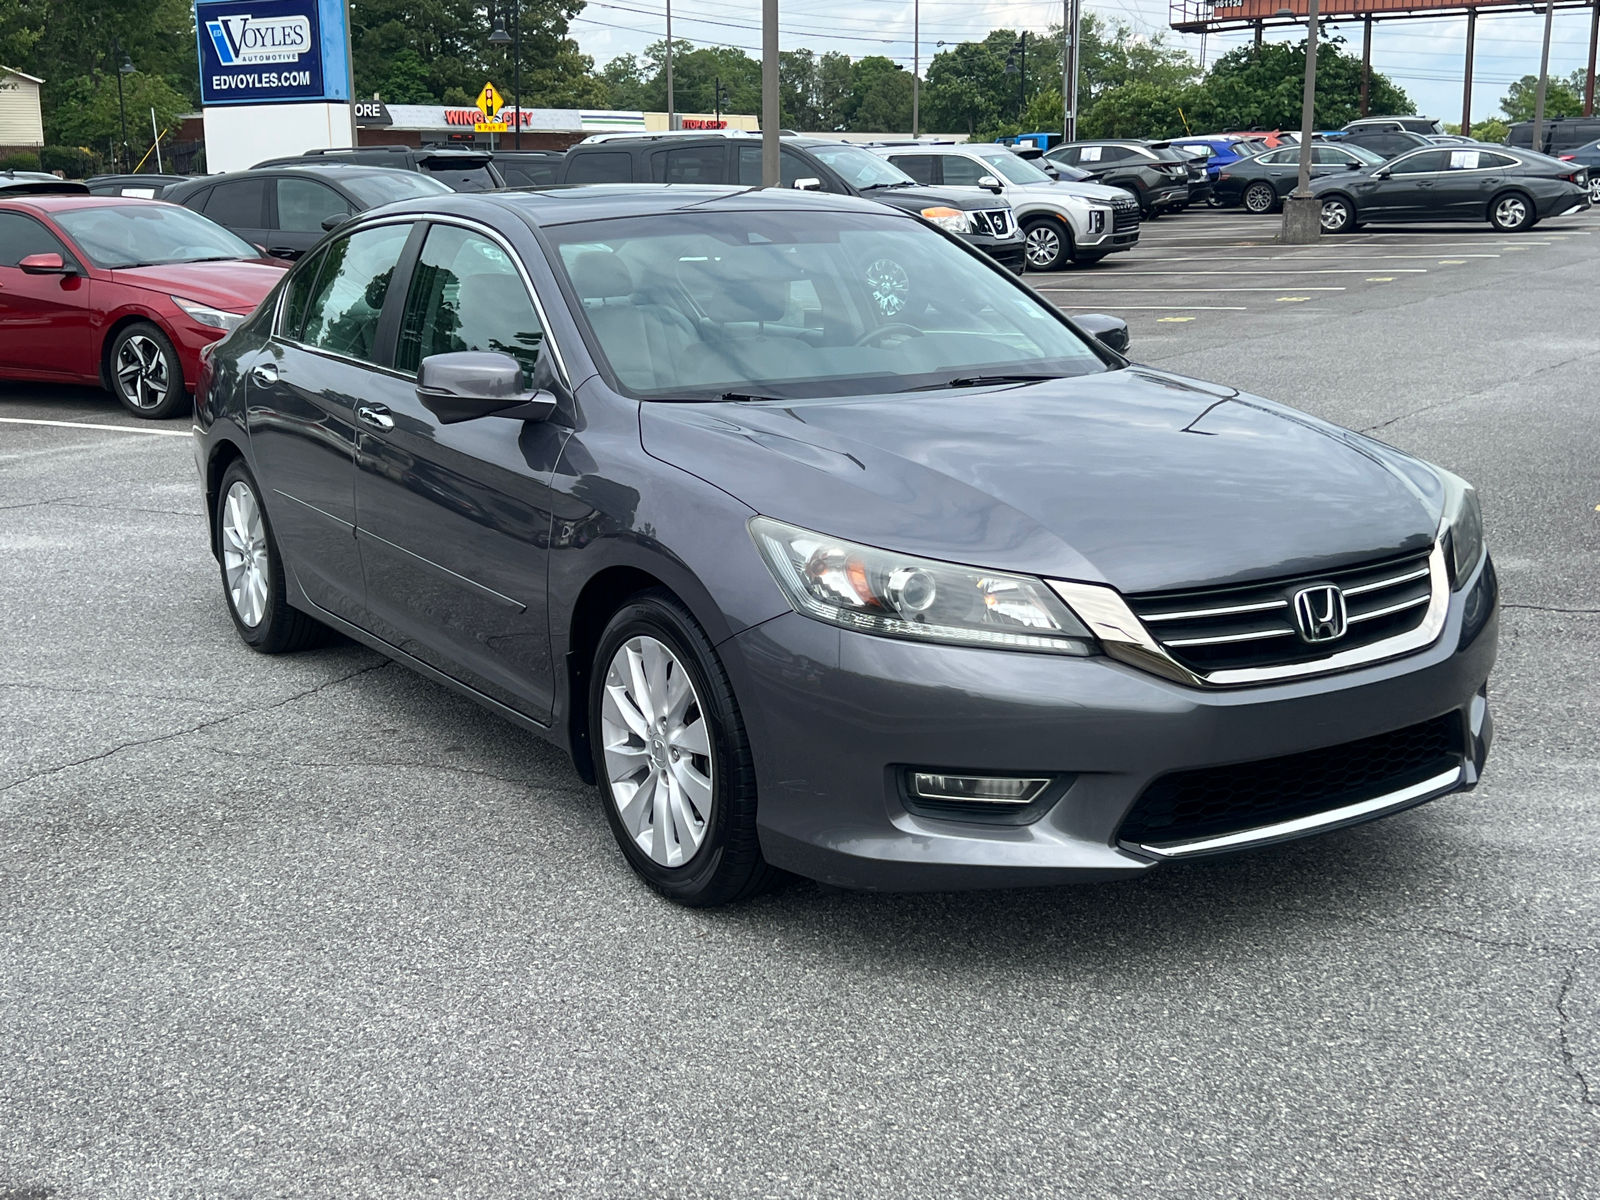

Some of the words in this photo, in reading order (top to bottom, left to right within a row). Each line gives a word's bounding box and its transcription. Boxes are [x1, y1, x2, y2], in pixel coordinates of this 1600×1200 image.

[221, 18, 304, 59] VOYLES
[242, 53, 297, 62] AUTOMOTIVE
[212, 71, 310, 90] EDVOYLES.COM
